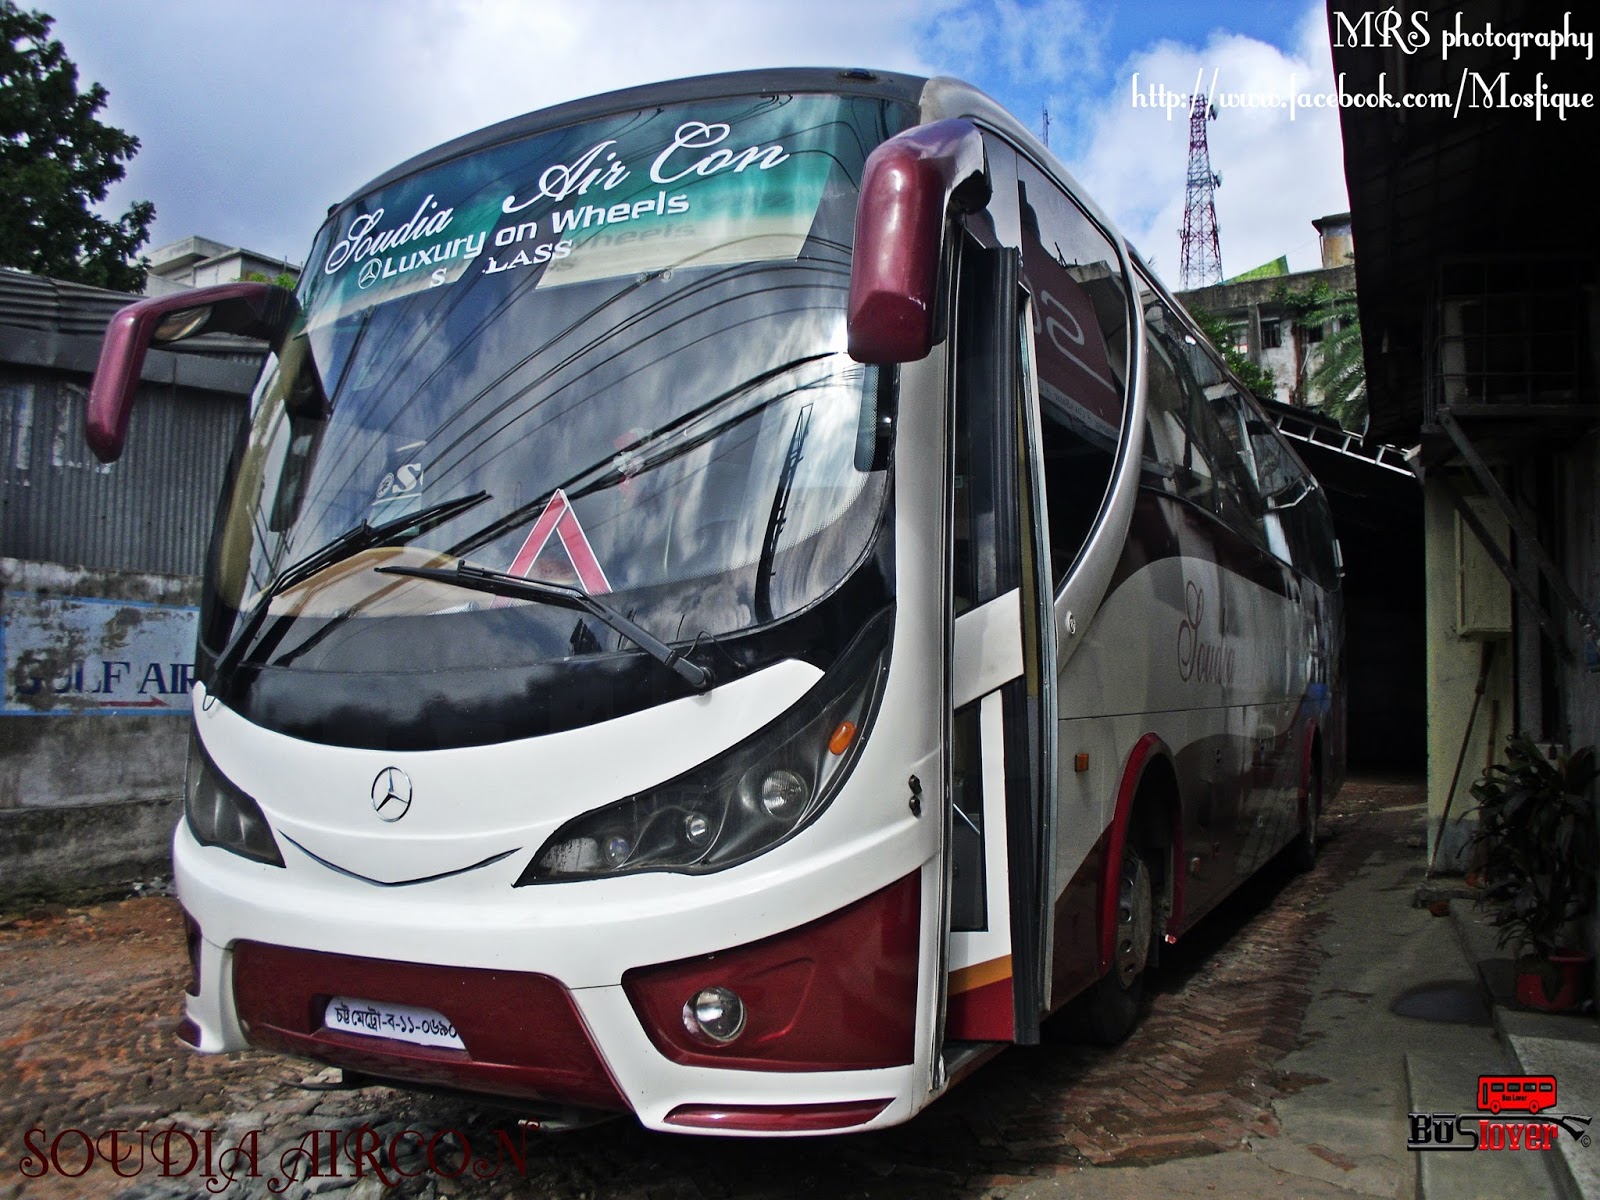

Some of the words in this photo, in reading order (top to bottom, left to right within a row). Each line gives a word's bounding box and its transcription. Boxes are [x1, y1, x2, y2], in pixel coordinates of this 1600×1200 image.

[324, 194, 454, 275] Soudia
[502, 140, 631, 215] Air
[650, 121, 791, 185] Con
[382, 230, 487, 279] Luxury
[494, 222, 539, 248] on
[551, 190, 691, 234] Wheels
